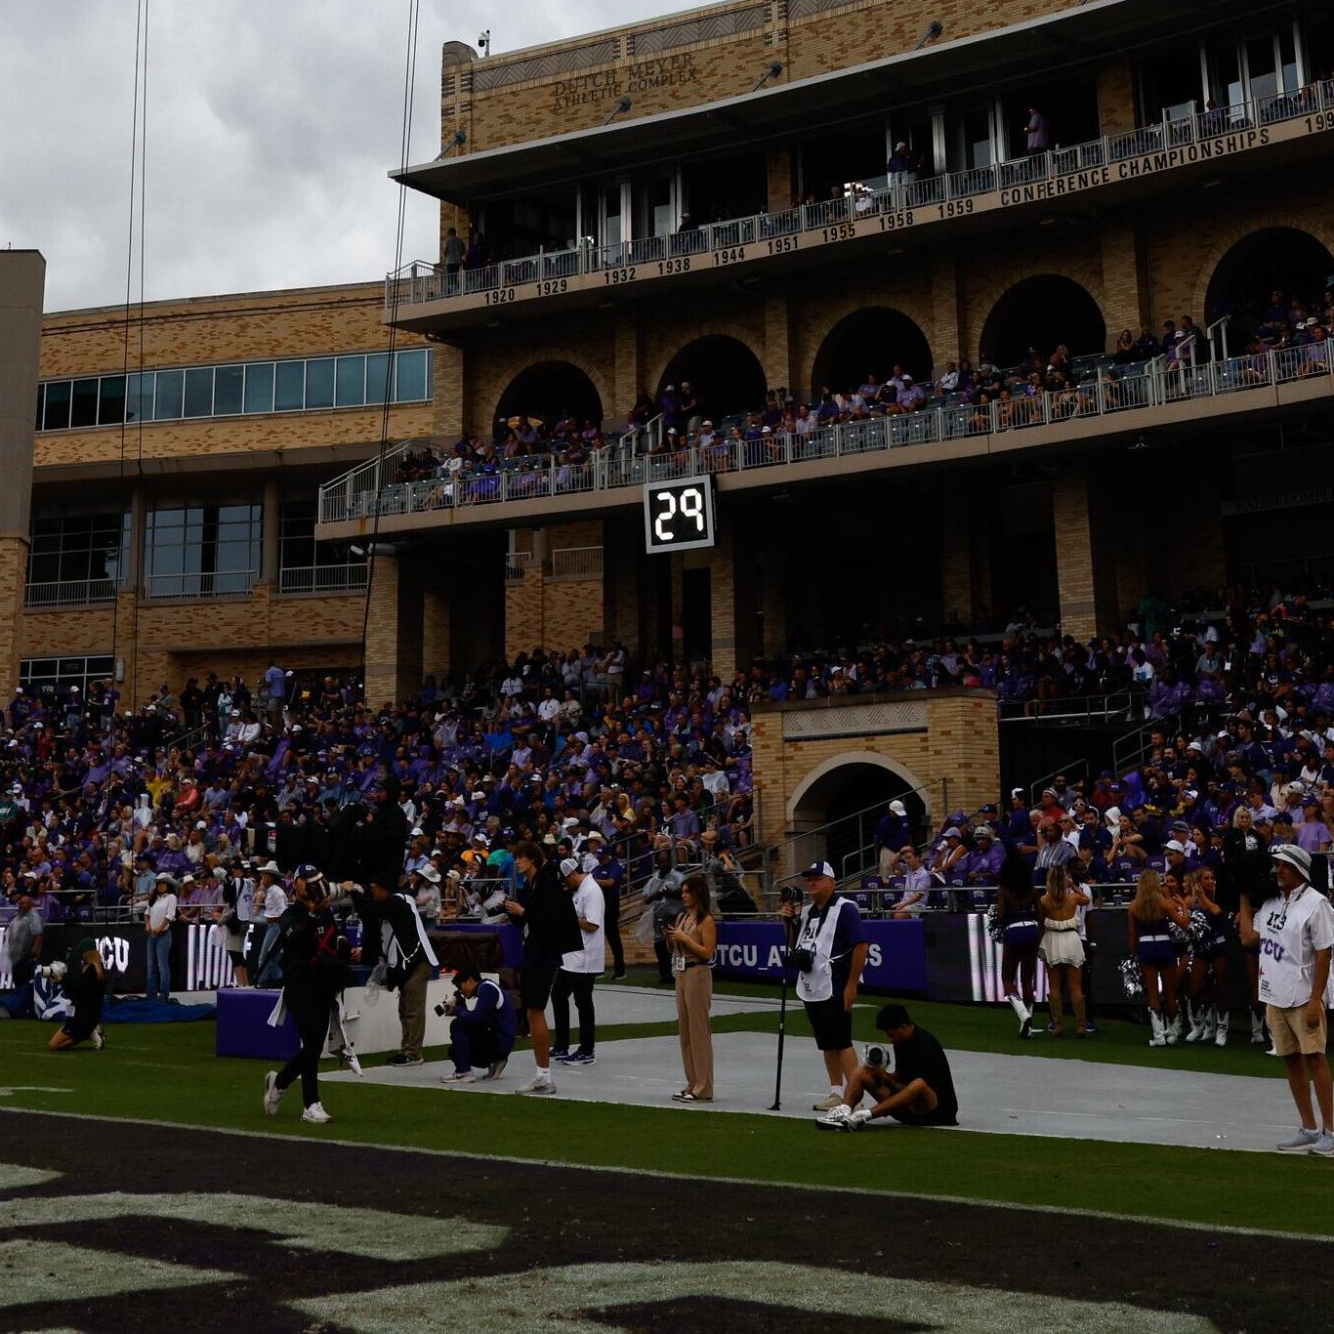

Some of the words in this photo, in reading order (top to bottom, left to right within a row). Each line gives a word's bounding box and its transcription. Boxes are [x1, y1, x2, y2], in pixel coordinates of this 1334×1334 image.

[553, 84, 621, 111] ATHLETIC
[628, 68, 697, 93] COMPLEX
[554, 69, 617, 97] DUTCH
[628, 53, 692, 80] MEYER
[485, 289, 515, 305] 1920
[536, 279, 567, 296] 1929
[604, 268, 636, 284] 1932
[658, 258, 690, 275] 1938
[714, 248, 745, 265] 1944
[768, 236, 798, 254] 1951
[823, 224, 856, 242] 1955
[879, 212, 913, 231] 1958
[938, 199, 973, 218] 1959
[1001, 167, 1110, 206] CONFERENCE
[1118, 128, 1270, 178] CHAMPIONSHIPS
[655, 488, 704, 541] 29
